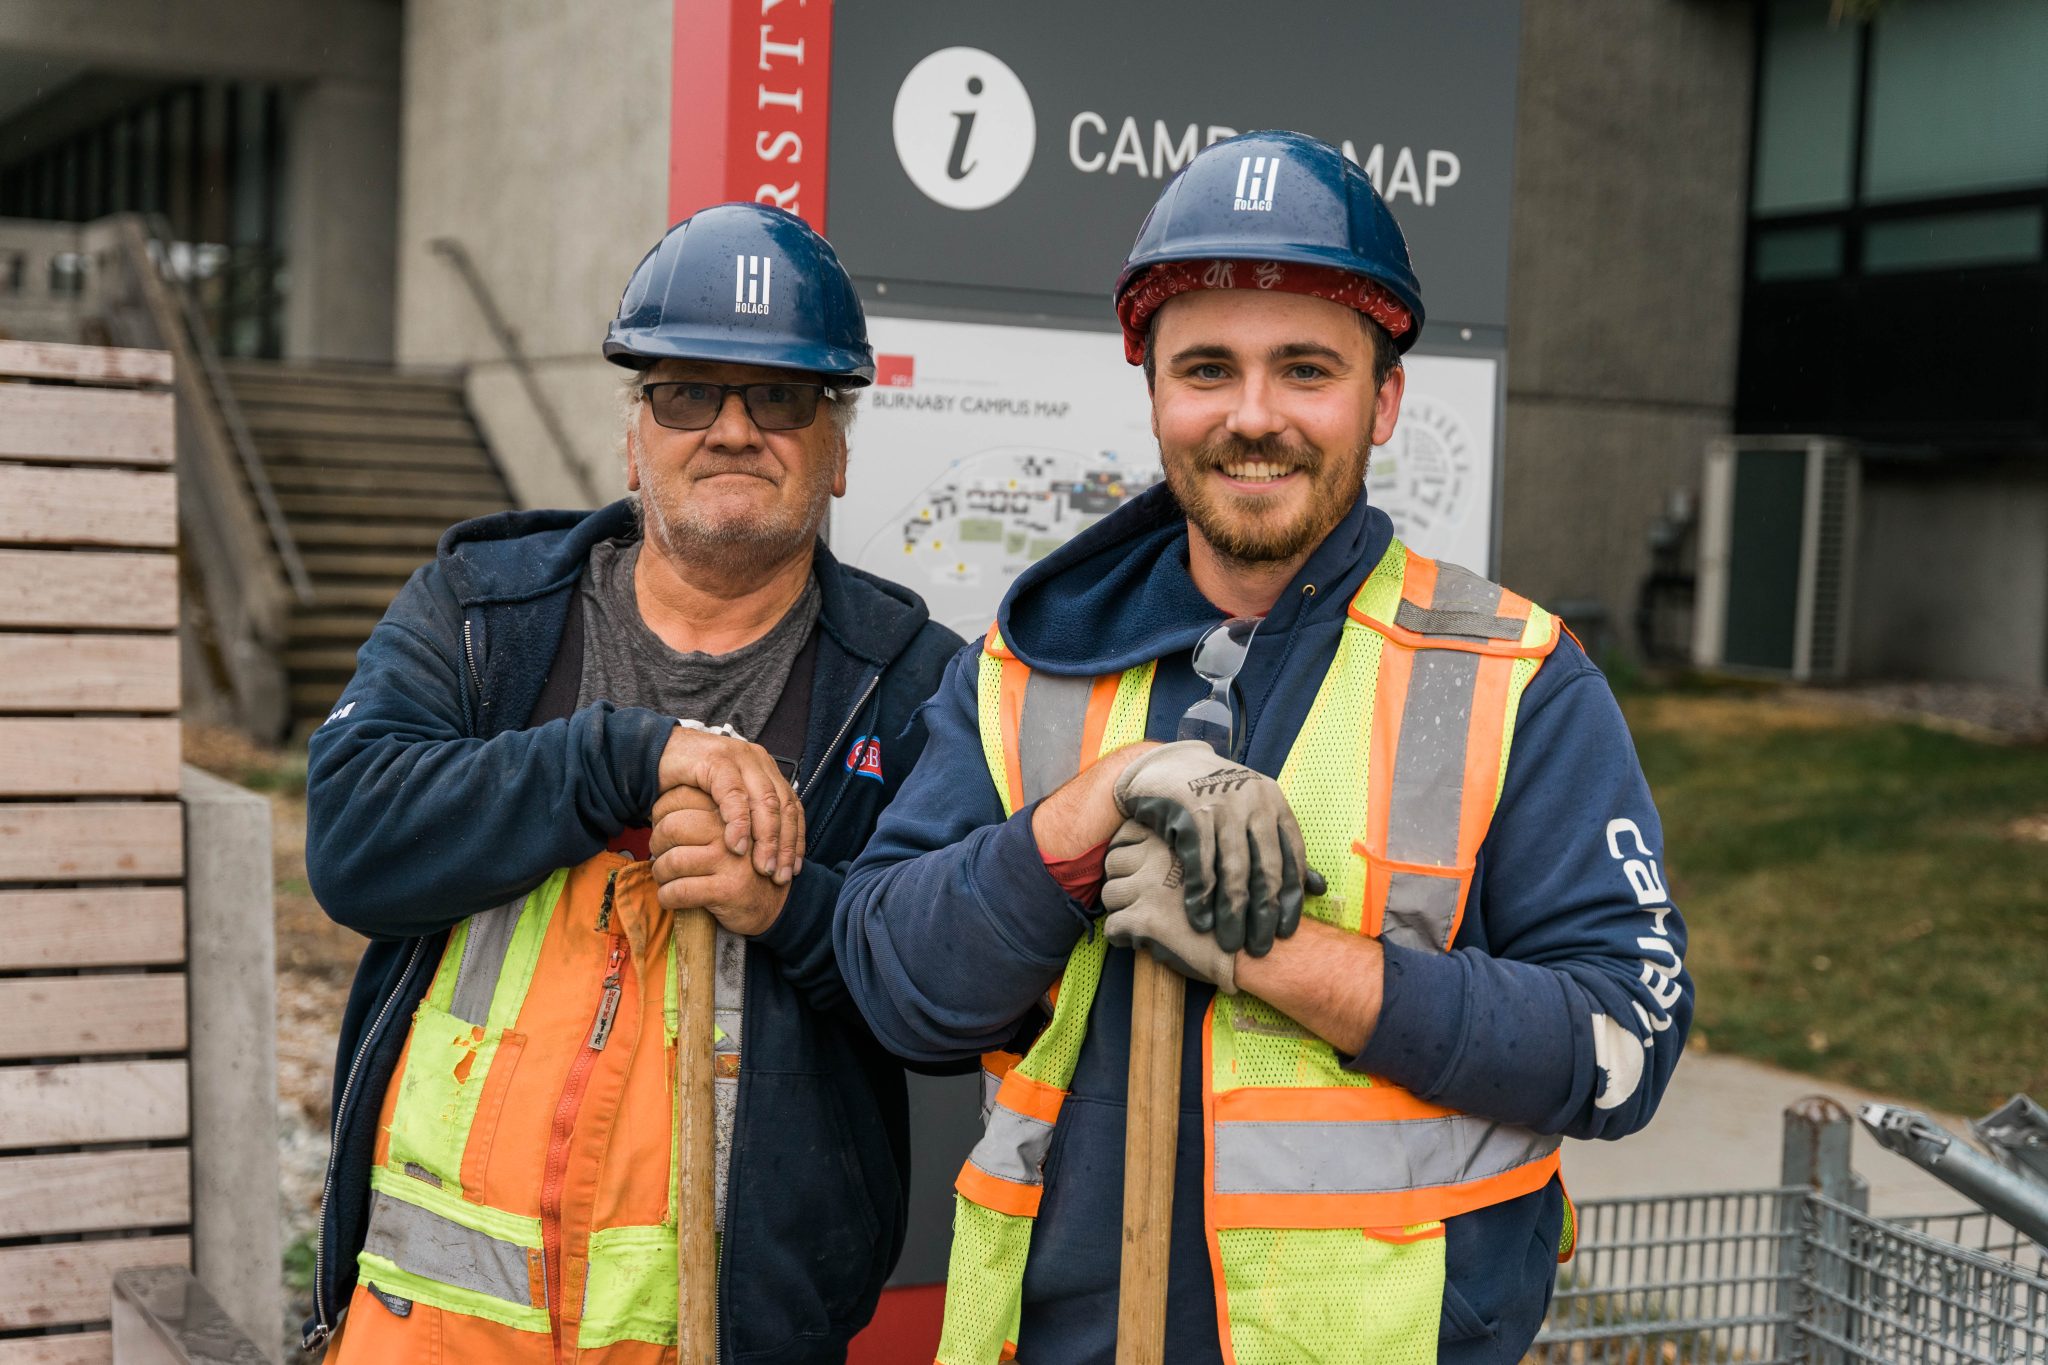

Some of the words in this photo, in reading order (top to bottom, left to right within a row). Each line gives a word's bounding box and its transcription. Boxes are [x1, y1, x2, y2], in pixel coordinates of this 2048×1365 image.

[1341, 139, 1461, 206] MAP
[1233, 199, 1273, 212] HOLACO
[735, 302, 770, 315] HOLACO
[872, 391, 955, 412] BURNABY
[960, 396, 1030, 417] CAMPUS
[1034, 400, 1071, 418] MAP
